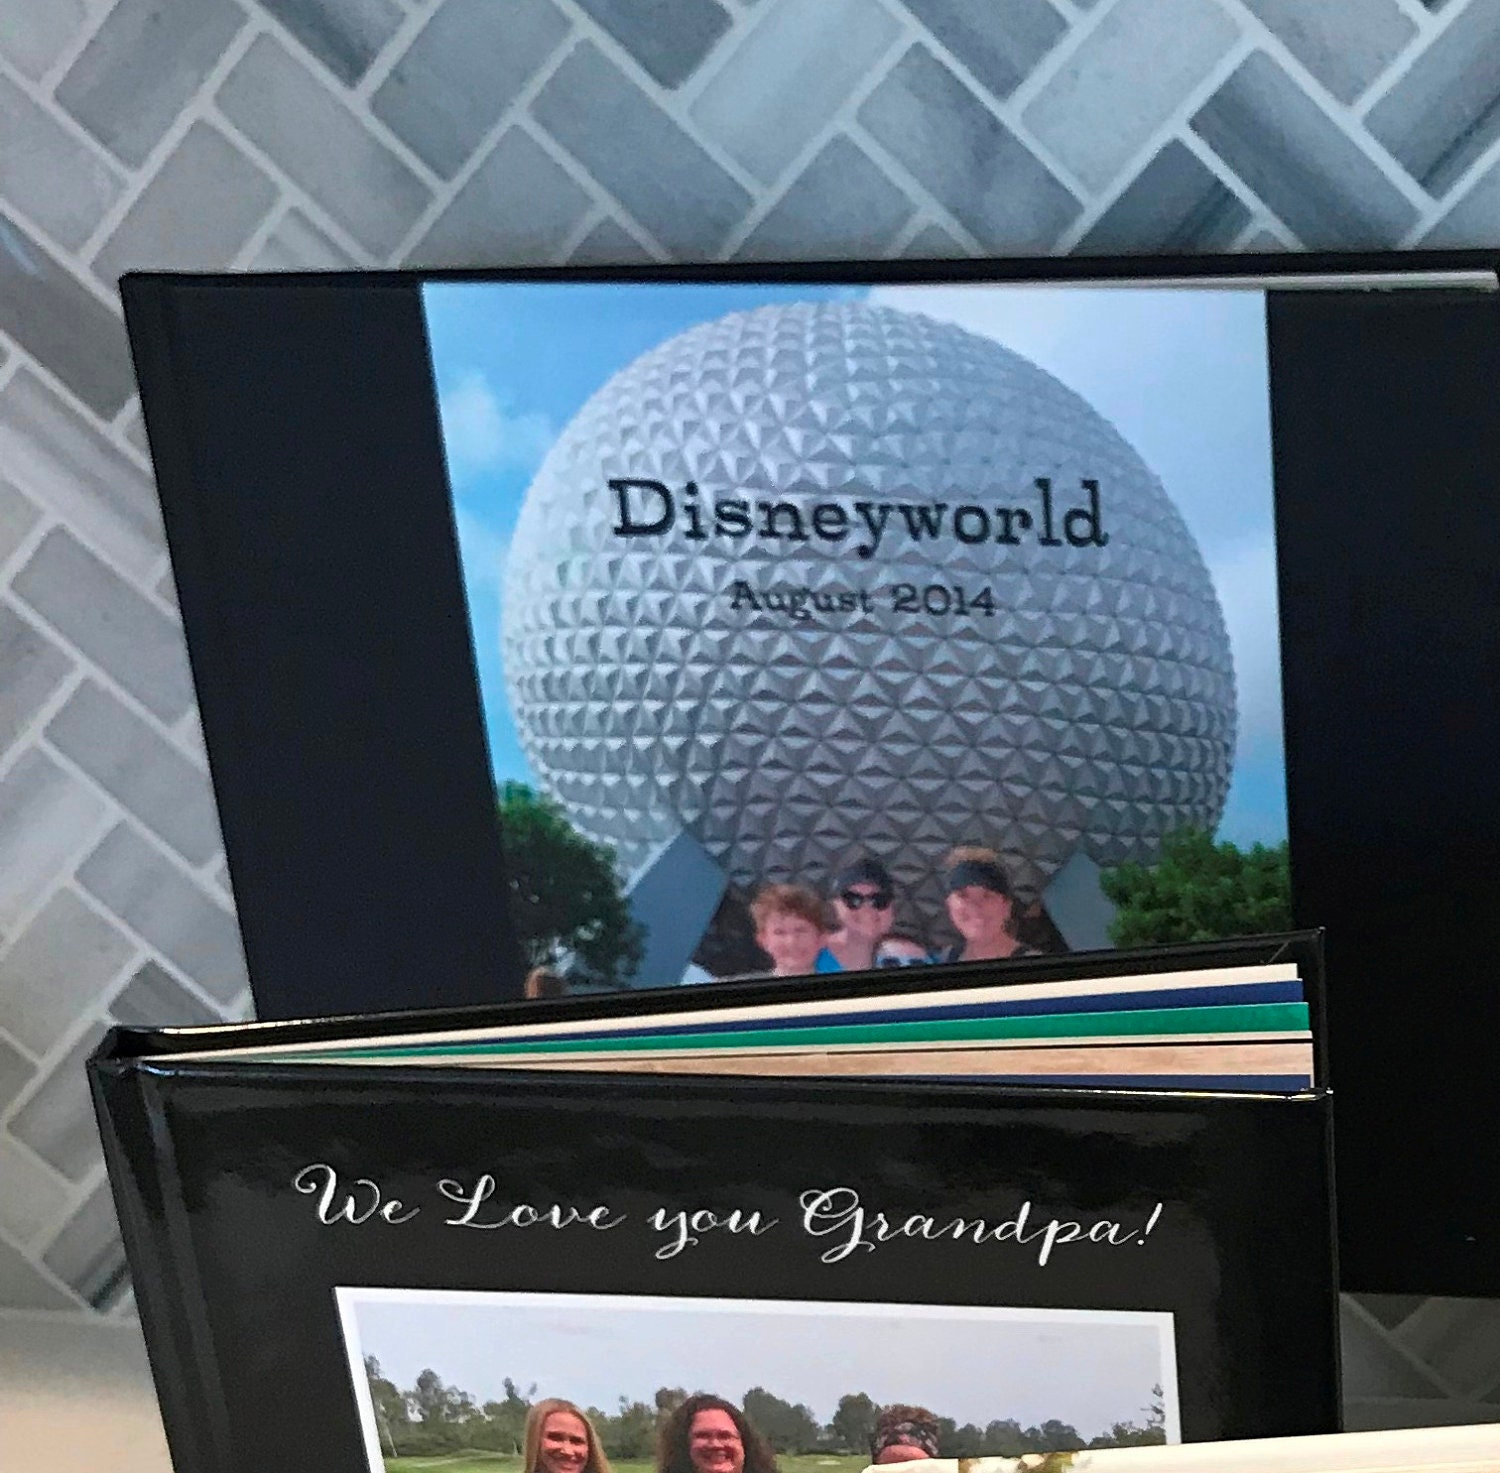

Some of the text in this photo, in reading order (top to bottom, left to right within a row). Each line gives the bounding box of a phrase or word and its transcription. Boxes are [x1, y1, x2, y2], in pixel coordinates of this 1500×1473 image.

[608, 477, 1109, 558] Disneyworld
[731, 580, 996, 620] August 2014
[294, 1163, 1164, 1268] We Love you Grandpa!
